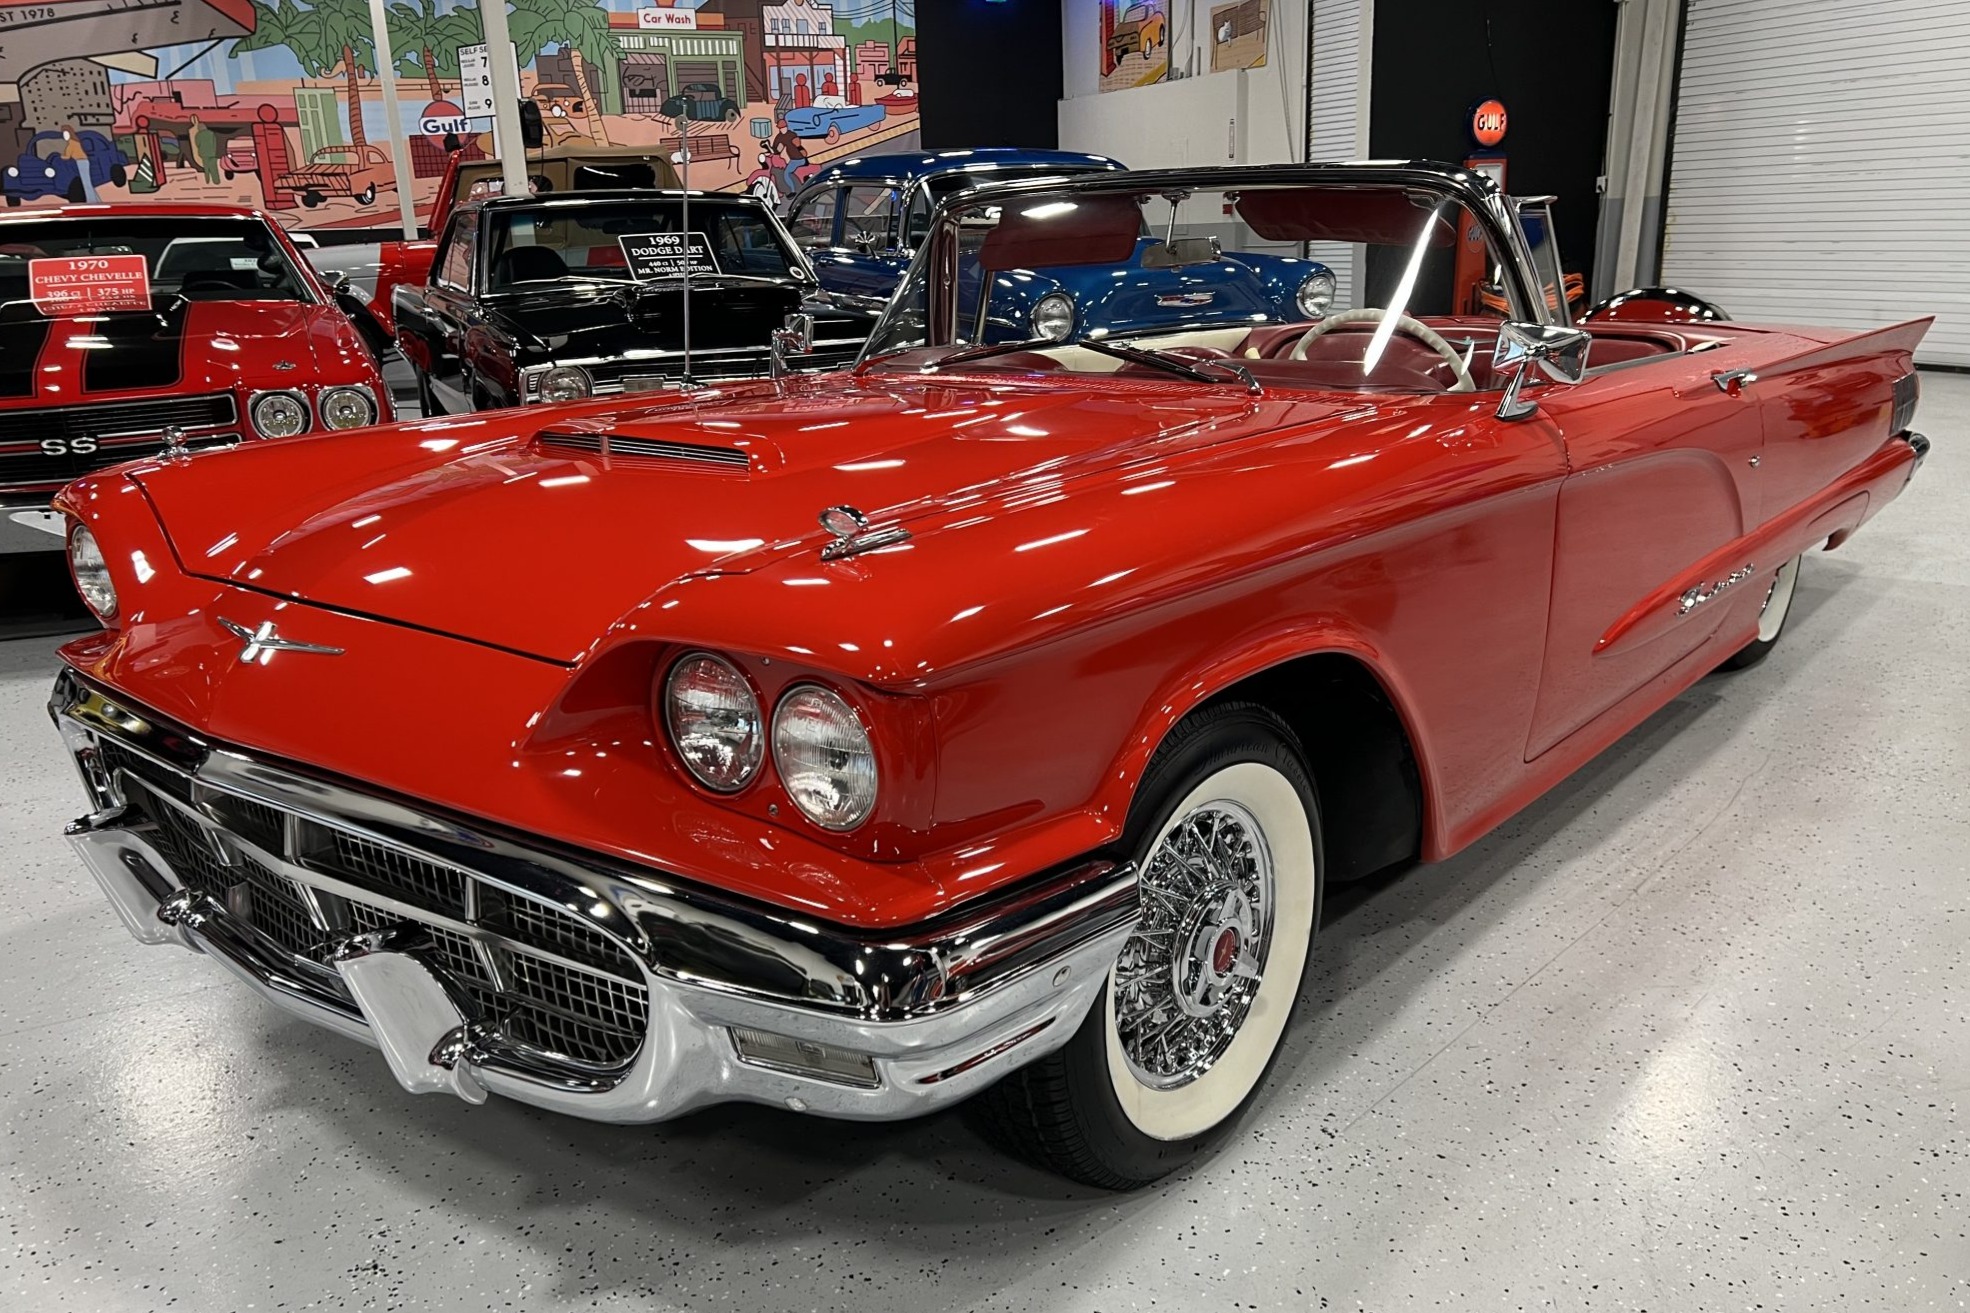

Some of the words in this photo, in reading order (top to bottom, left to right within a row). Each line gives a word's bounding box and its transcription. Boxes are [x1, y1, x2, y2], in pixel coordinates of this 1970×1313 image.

[20, 7, 55, 20] 1978
[643, 13, 661, 23] Car
[665, 13, 691, 24] Wash
[460, 46, 478, 55] SELF
[422, 118, 468, 133] Gulf
[1477, 113, 1505, 131] GULF
[648, 235, 680, 245] 1969
[631, 246, 673, 256] DODGE
[69, 260, 109, 270] 1970
[35, 274, 78, 284] CHEVY
[80, 271, 143, 281] CHEVELLE
[46, 289, 68, 298] 396
[97, 287, 119, 296] 375
[40, 436, 97, 456] SS
